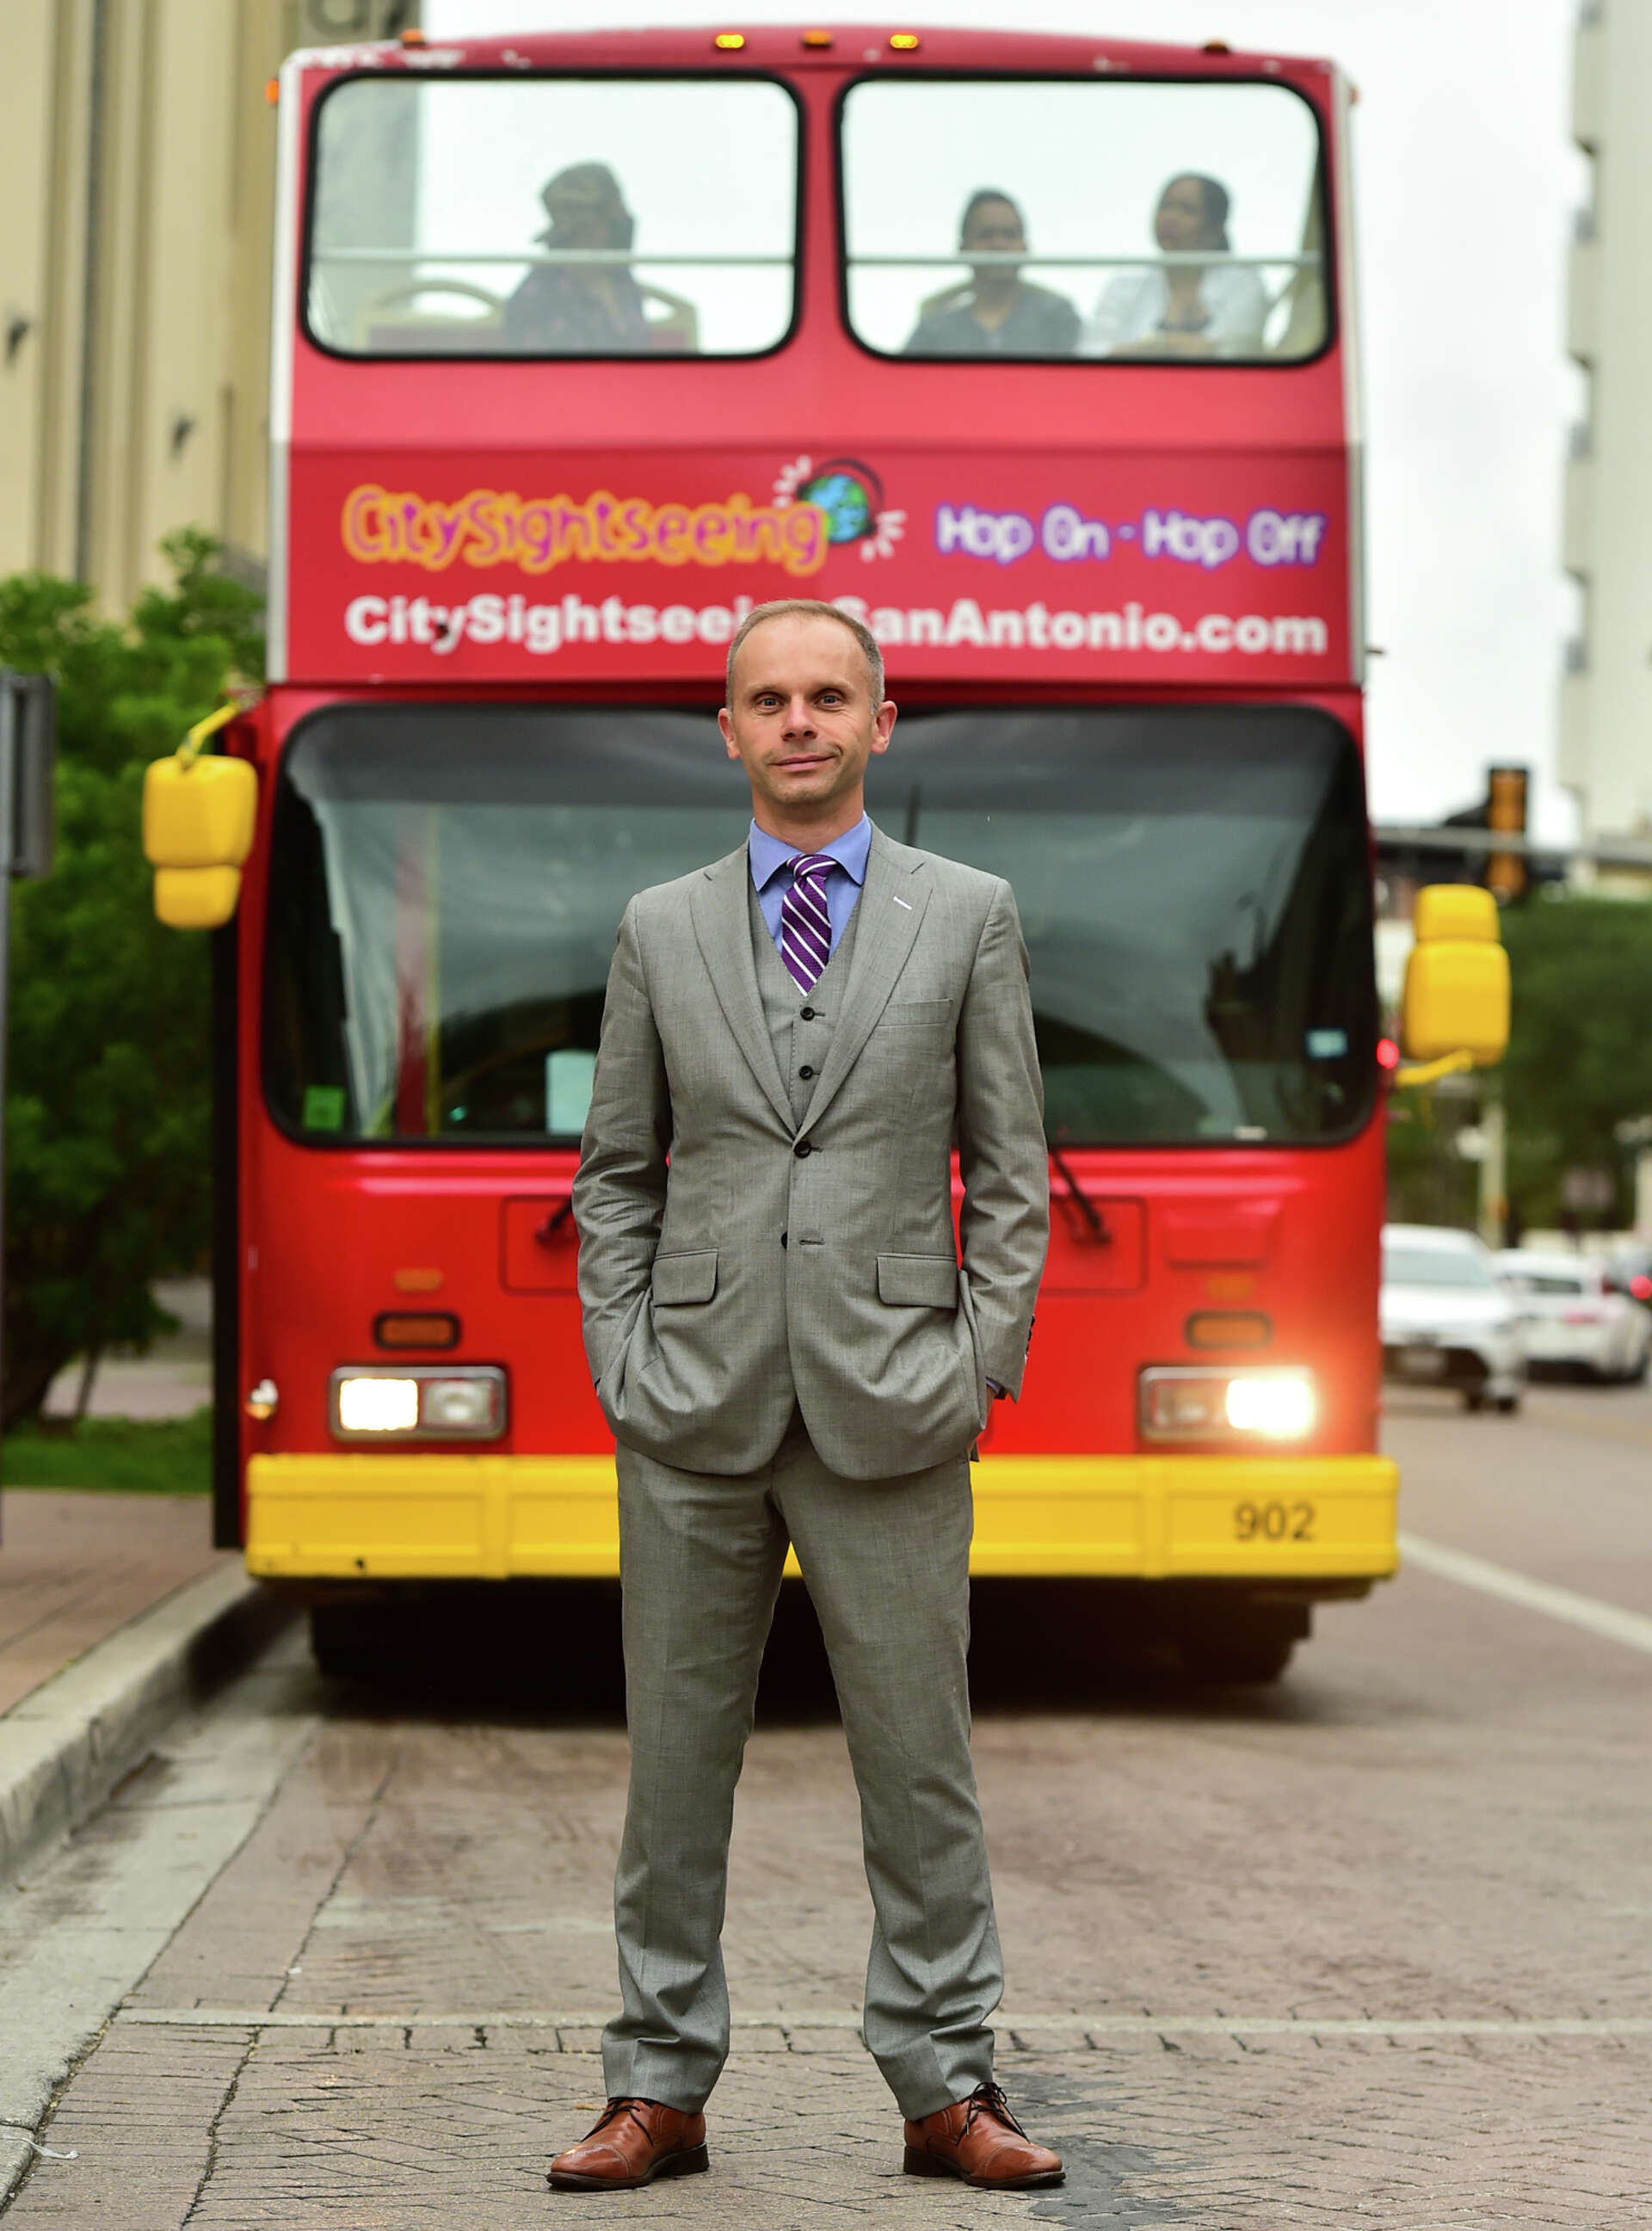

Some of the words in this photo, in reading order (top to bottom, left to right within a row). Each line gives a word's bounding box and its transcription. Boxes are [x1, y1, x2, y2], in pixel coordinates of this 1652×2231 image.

[342, 485, 830, 575] CitySightseeing
[933, 501, 1035, 568] Hop
[1039, 502, 1112, 563] On
[1141, 507, 1240, 571] Hop
[1244, 507, 1325, 568] Off
[1234, 1501, 1316, 1542] 902
